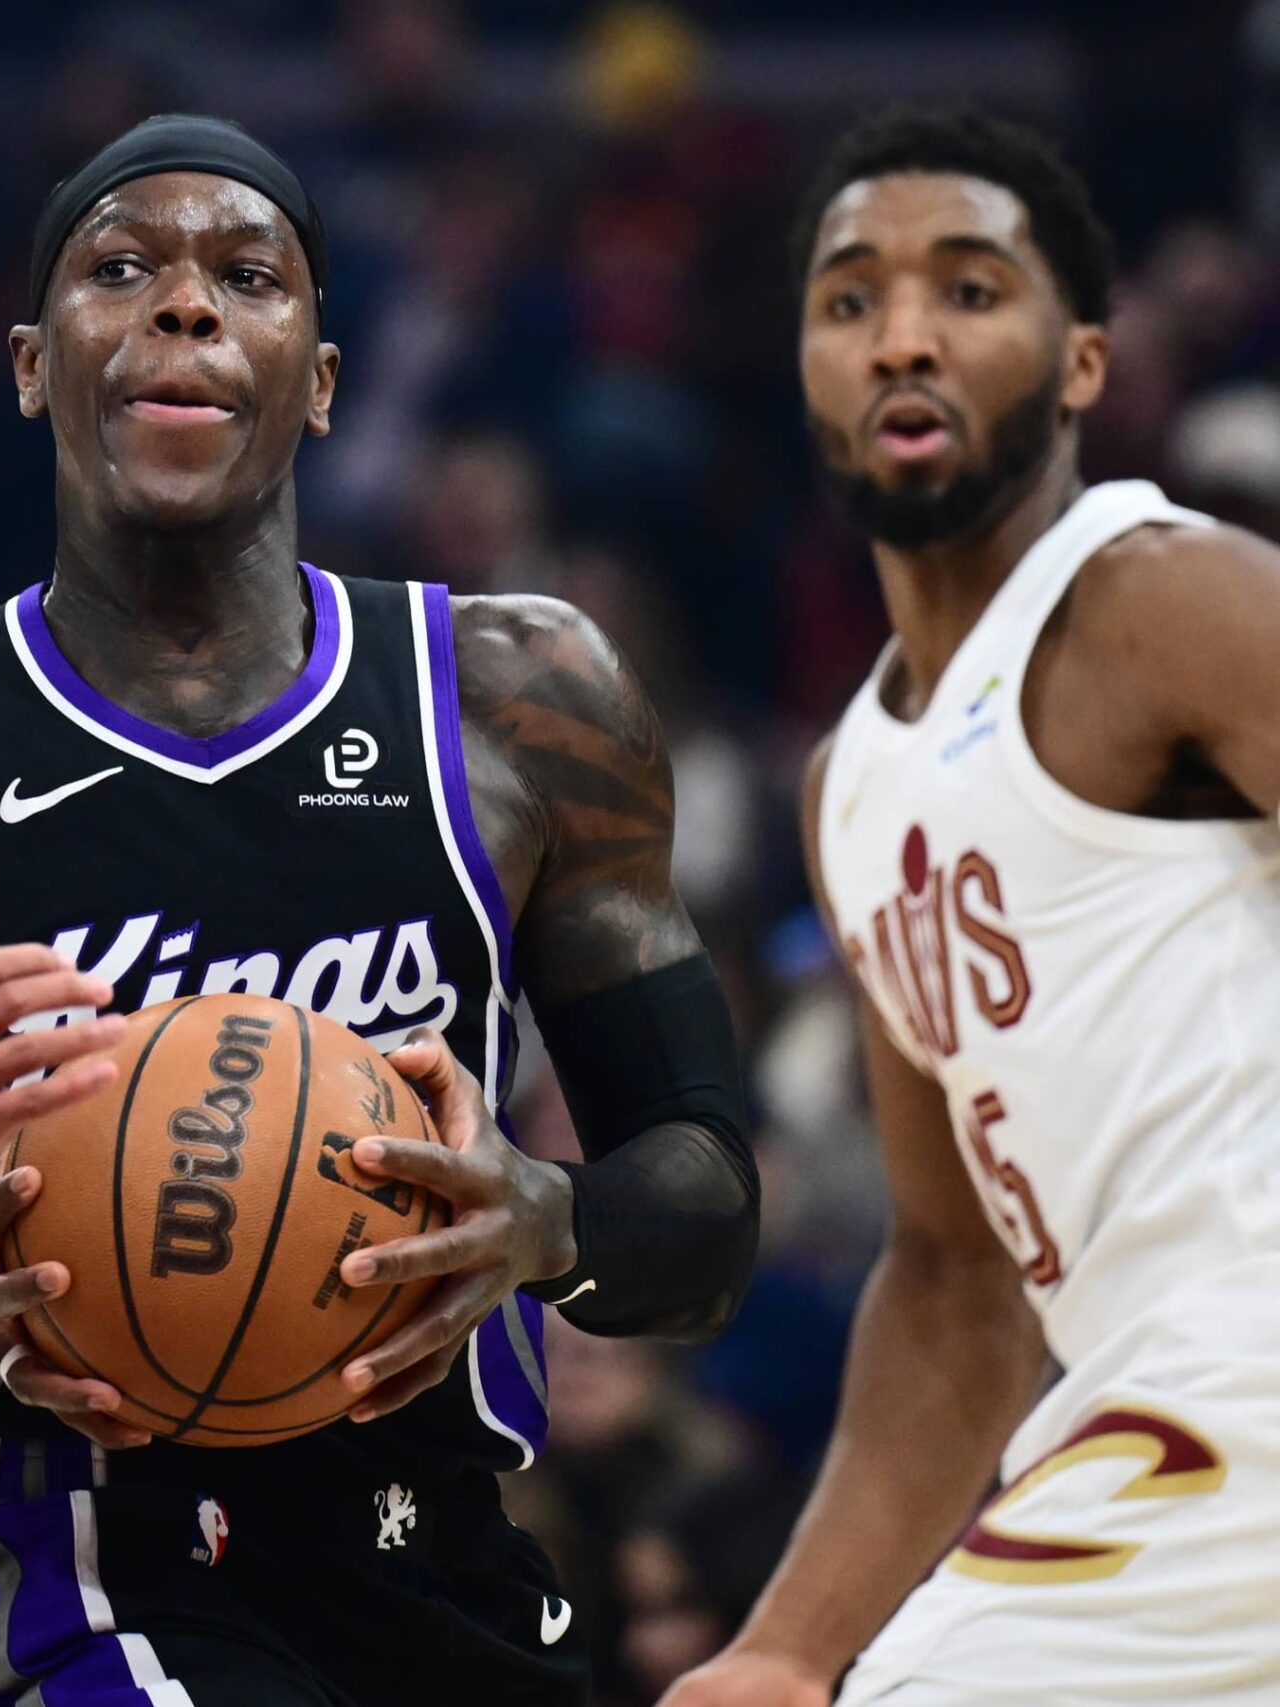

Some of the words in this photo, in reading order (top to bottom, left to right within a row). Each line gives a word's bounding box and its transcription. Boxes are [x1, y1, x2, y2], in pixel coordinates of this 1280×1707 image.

[299, 793, 370, 807] PHOONG
[373, 794, 410, 807] LAW
[151, 1013, 279, 1279] Wilson
